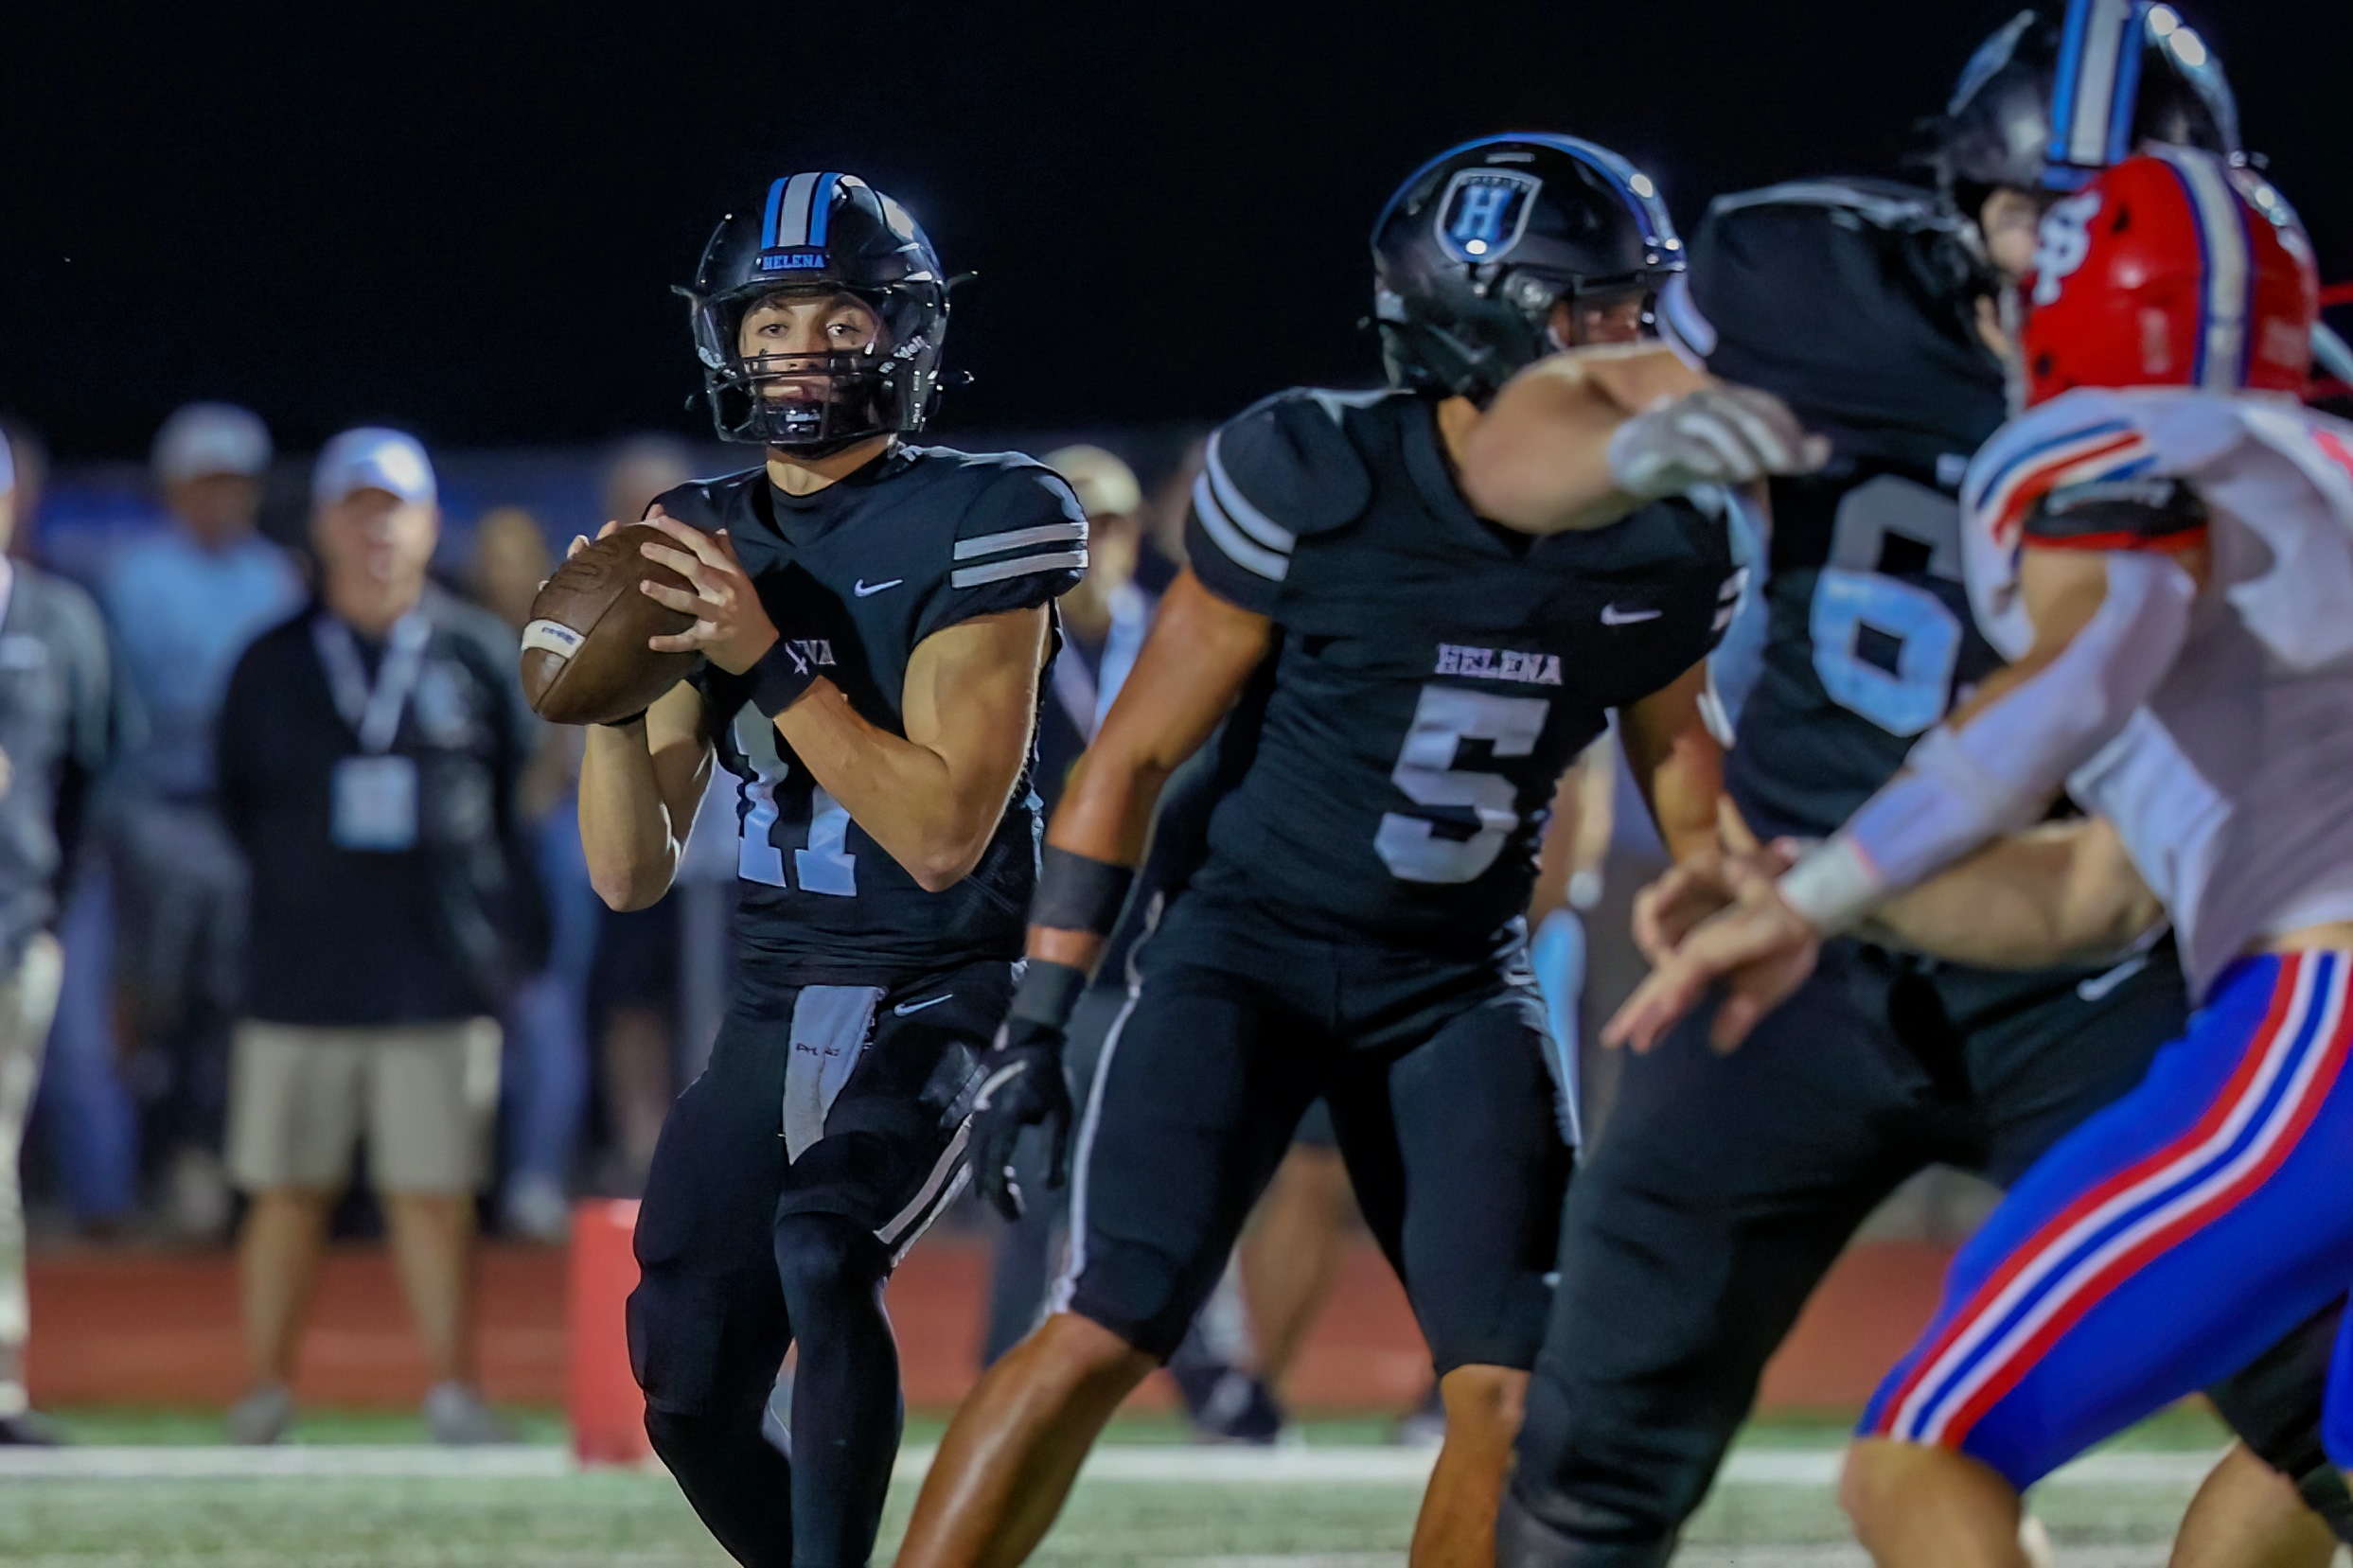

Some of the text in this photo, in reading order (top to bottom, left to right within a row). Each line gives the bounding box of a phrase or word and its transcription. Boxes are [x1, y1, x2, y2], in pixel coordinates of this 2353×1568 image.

[762, 255, 825, 271] HELENA
[1434, 643, 1563, 685] HELENA
[1373, 683, 1550, 884] 5
